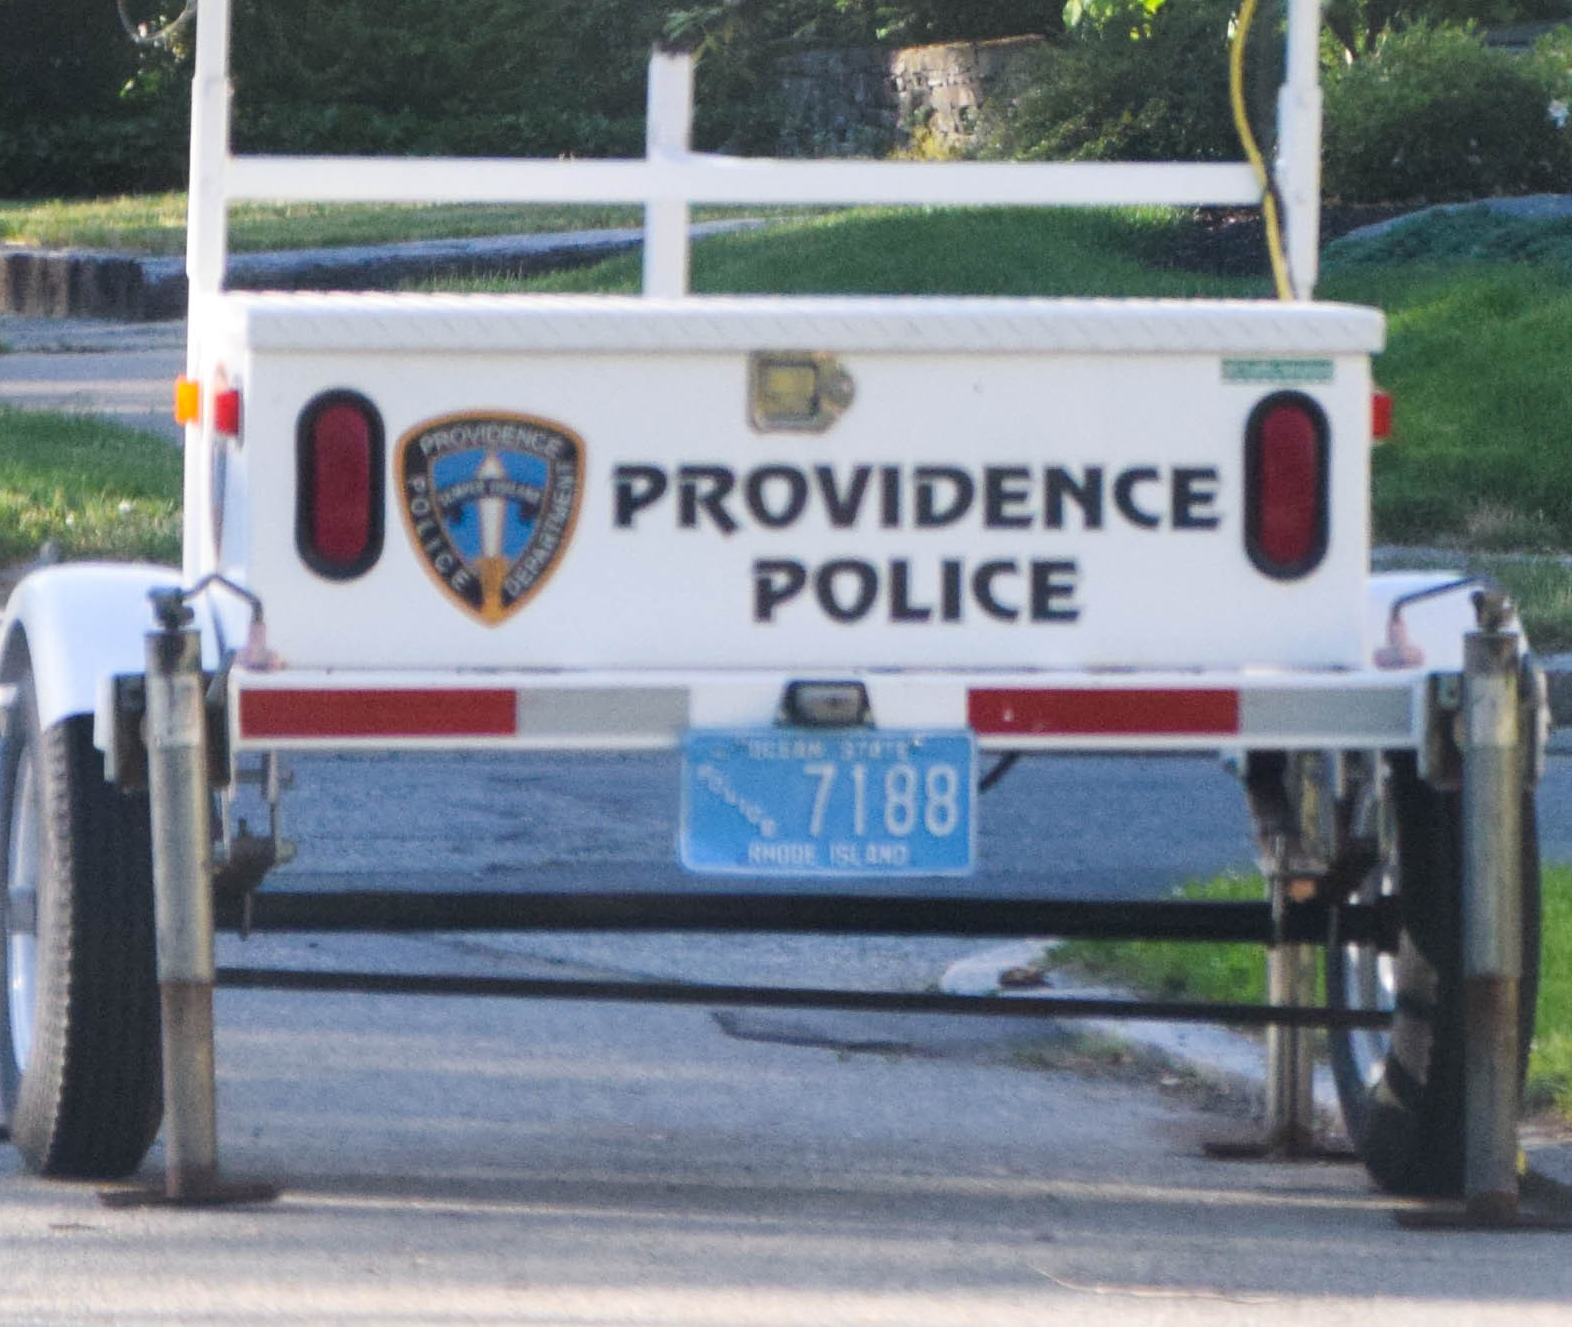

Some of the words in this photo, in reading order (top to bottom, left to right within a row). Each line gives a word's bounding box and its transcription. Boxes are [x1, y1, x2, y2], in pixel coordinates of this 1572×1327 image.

[419, 423, 563, 459] PROVIDENCE
[409, 474, 472, 592] POLICE
[612, 463, 1221, 535] PROVIDENCE
[753, 558, 1080, 624] POLICE
[803, 763, 958, 838] 7188
[747, 841, 818, 866] RHODE
[829, 841, 910, 866] ISLAND
